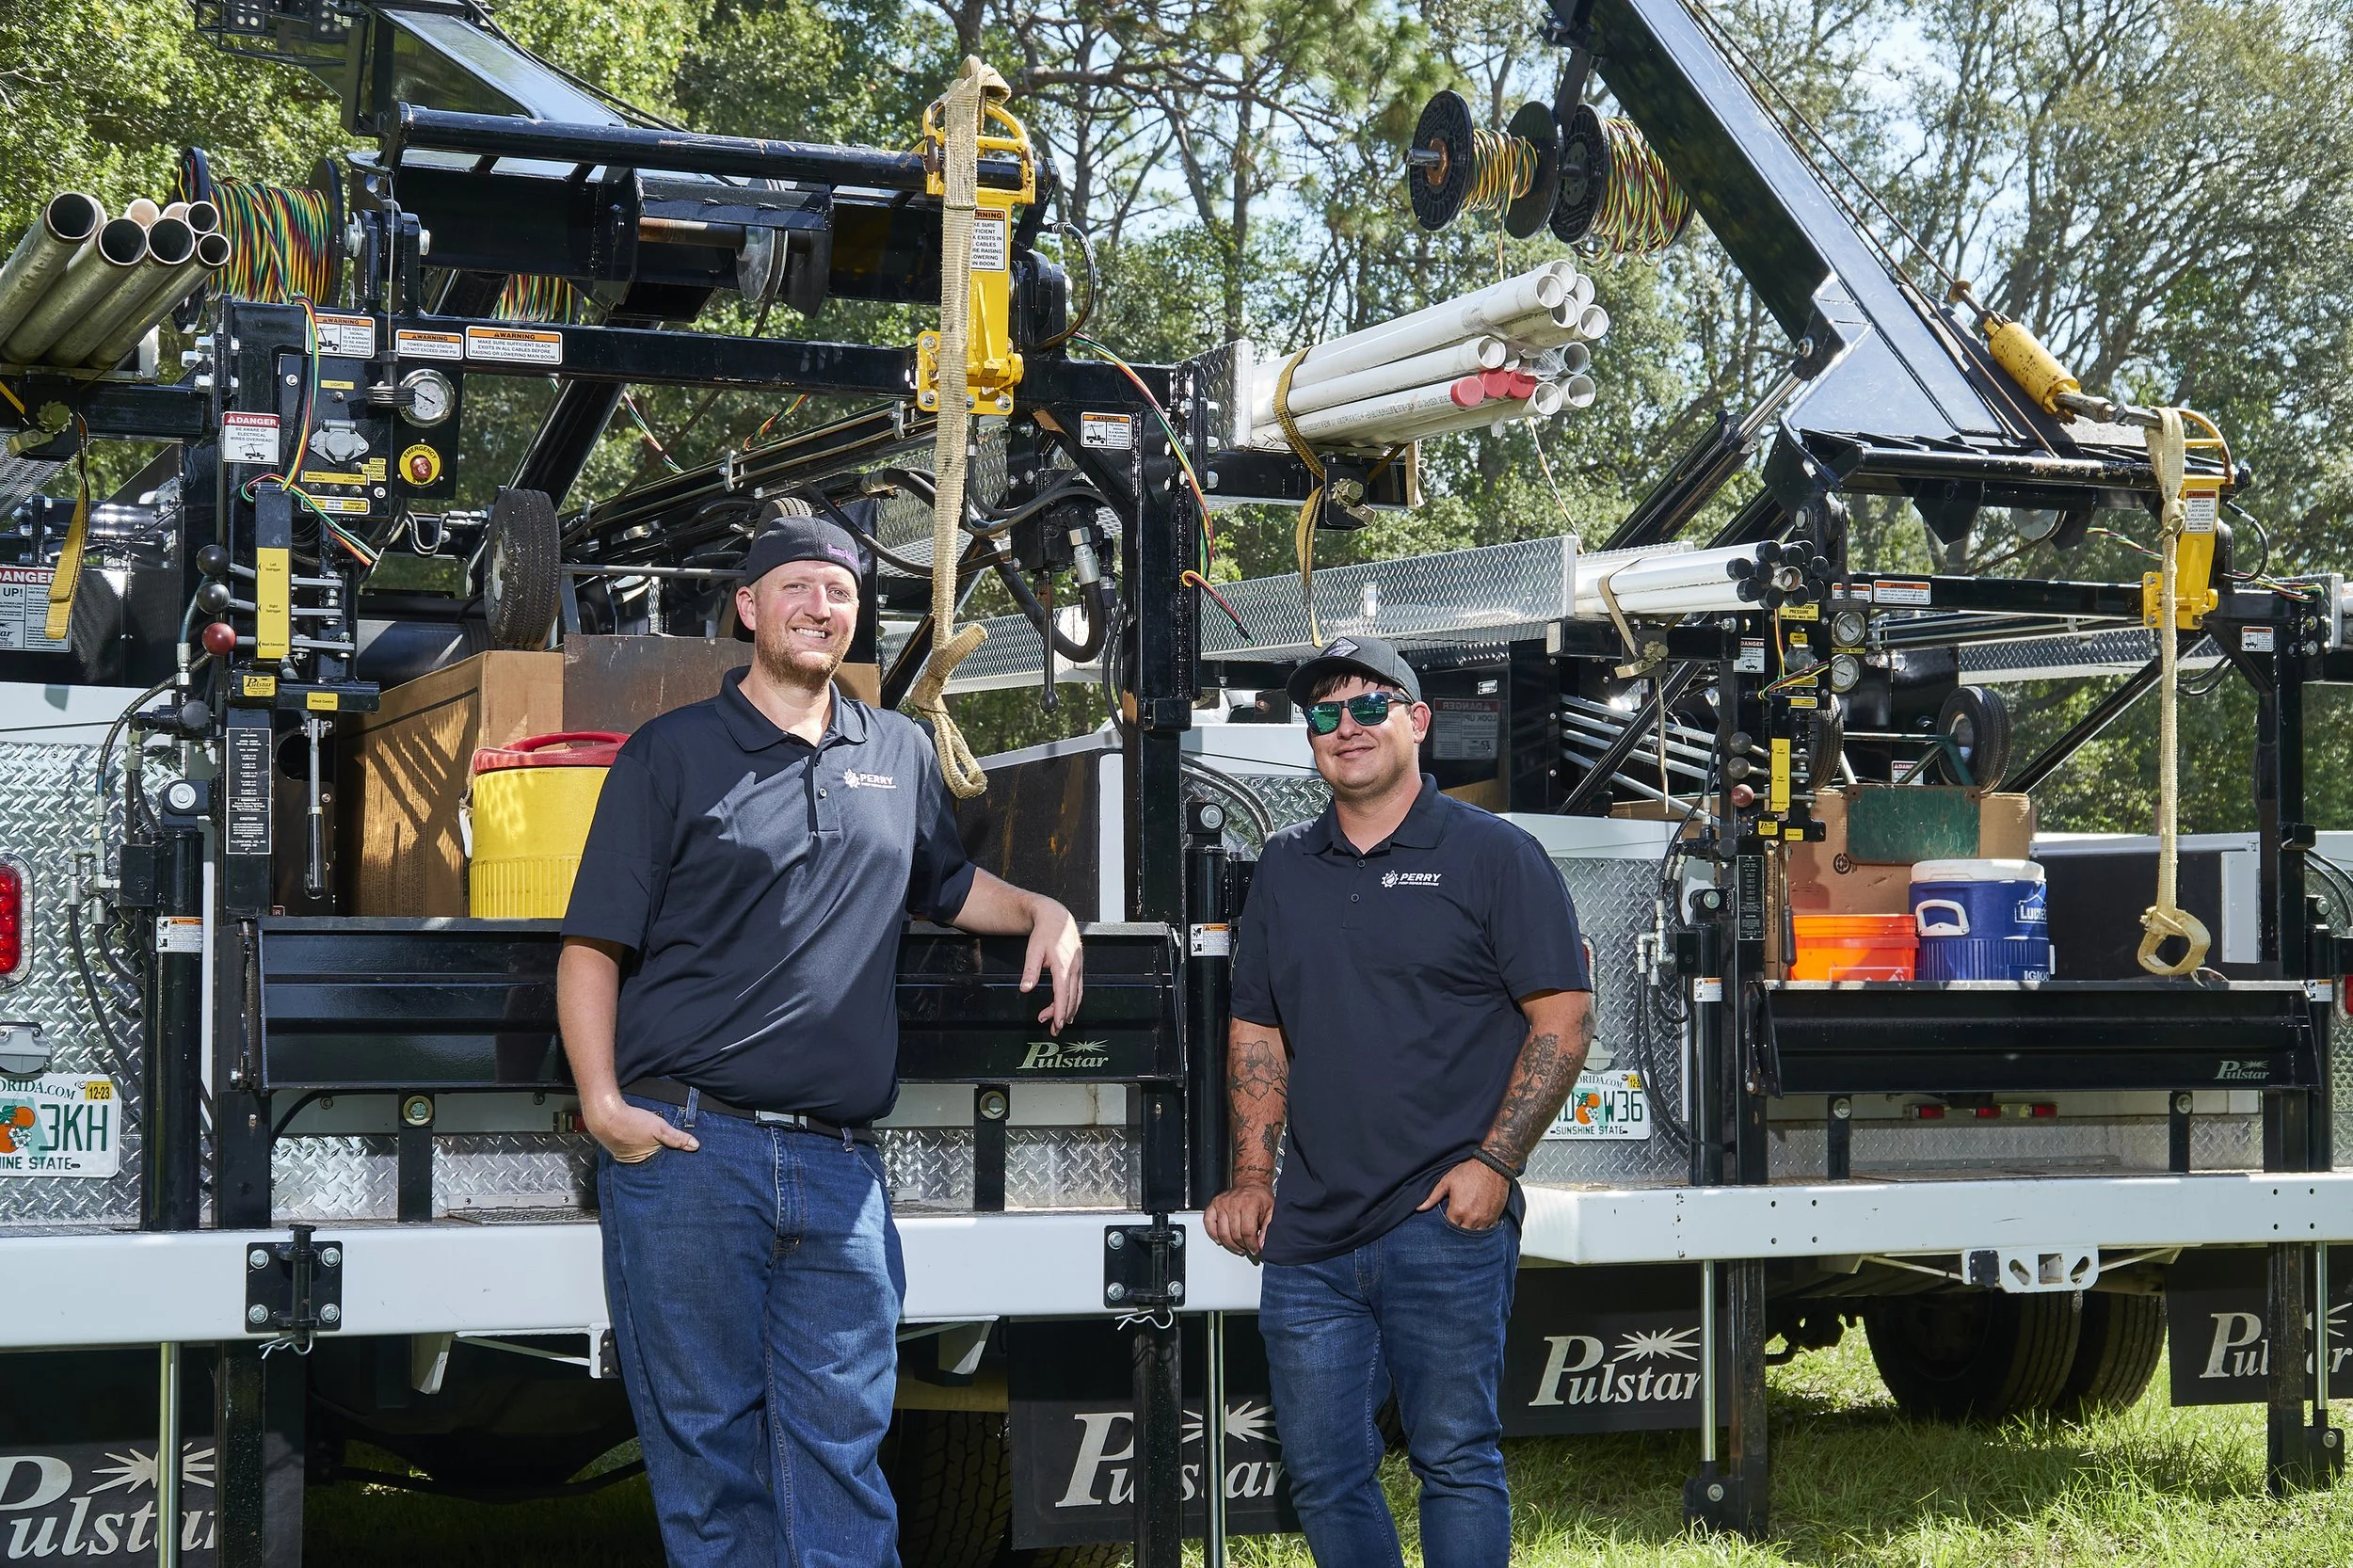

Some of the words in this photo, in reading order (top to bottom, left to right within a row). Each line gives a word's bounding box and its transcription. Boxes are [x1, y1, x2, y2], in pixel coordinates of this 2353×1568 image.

[236, 417, 276, 425] DANGER
[403, 445, 438, 459] EMERGENCY
[4, 588, 23, 597] UP!
[246, 678, 272, 687] Pulstar
[860, 774, 893, 785] PERRY
[1400, 873, 1442, 882] PERRY
[1016, 1042, 1109, 1068] Pulstar
[2214, 1060, 2270, 1080] Pulstar
[1604, 1091, 1642, 1122] W36
[38, 1104, 107, 1151] 3KH
[1556, 1126, 1594, 1134] SUNSHINE
[1599, 1126, 1623, 1134] STATE
[29, 1157, 72, 1169] STATE
[1529, 1336, 1701, 1406] Pulstar
[1055, 1412, 1284, 1508] Pusar
